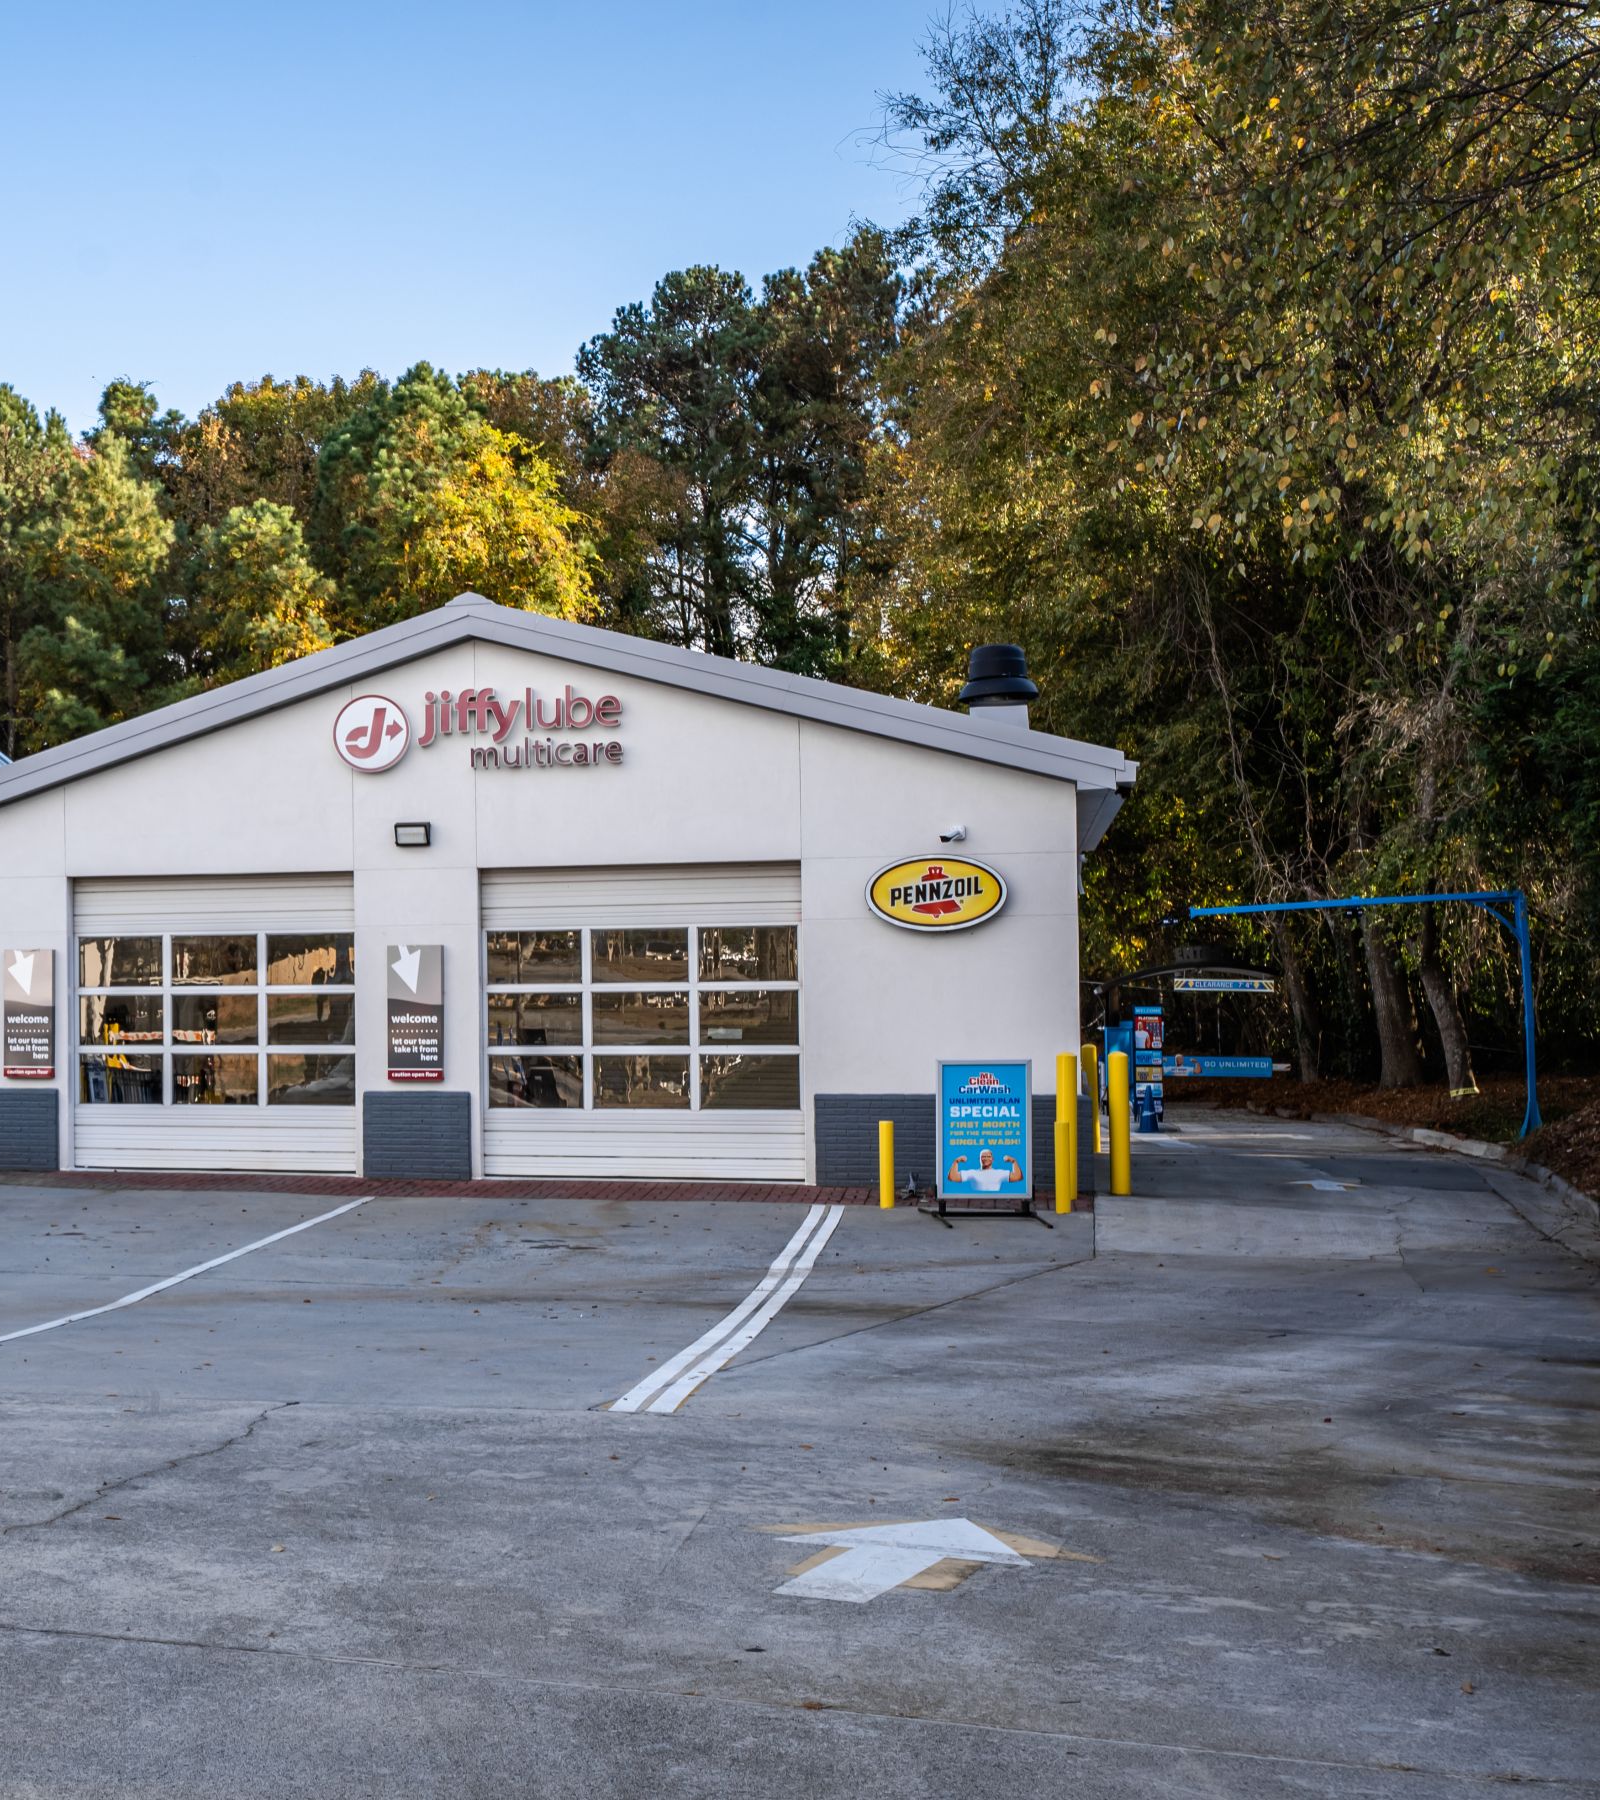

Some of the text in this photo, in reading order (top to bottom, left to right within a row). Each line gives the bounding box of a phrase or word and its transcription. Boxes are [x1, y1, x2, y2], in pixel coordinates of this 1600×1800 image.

[470, 737, 624, 769] multicare
[890, 876, 983, 907] PENNZOIL
[7, 1014, 49, 1024] welcome
[391, 1013, 438, 1024] welcome
[8, 1036, 17, 1044] let
[392, 1037, 402, 1045] let
[9, 1044, 49, 1052] take it from
[394, 1045, 438, 1053] take it from
[32, 1052, 49, 1060] here
[420, 1053, 438, 1061] here
[969, 1077, 999, 1086] Clean
[950, 1106, 1020, 1118] SPECIAL
